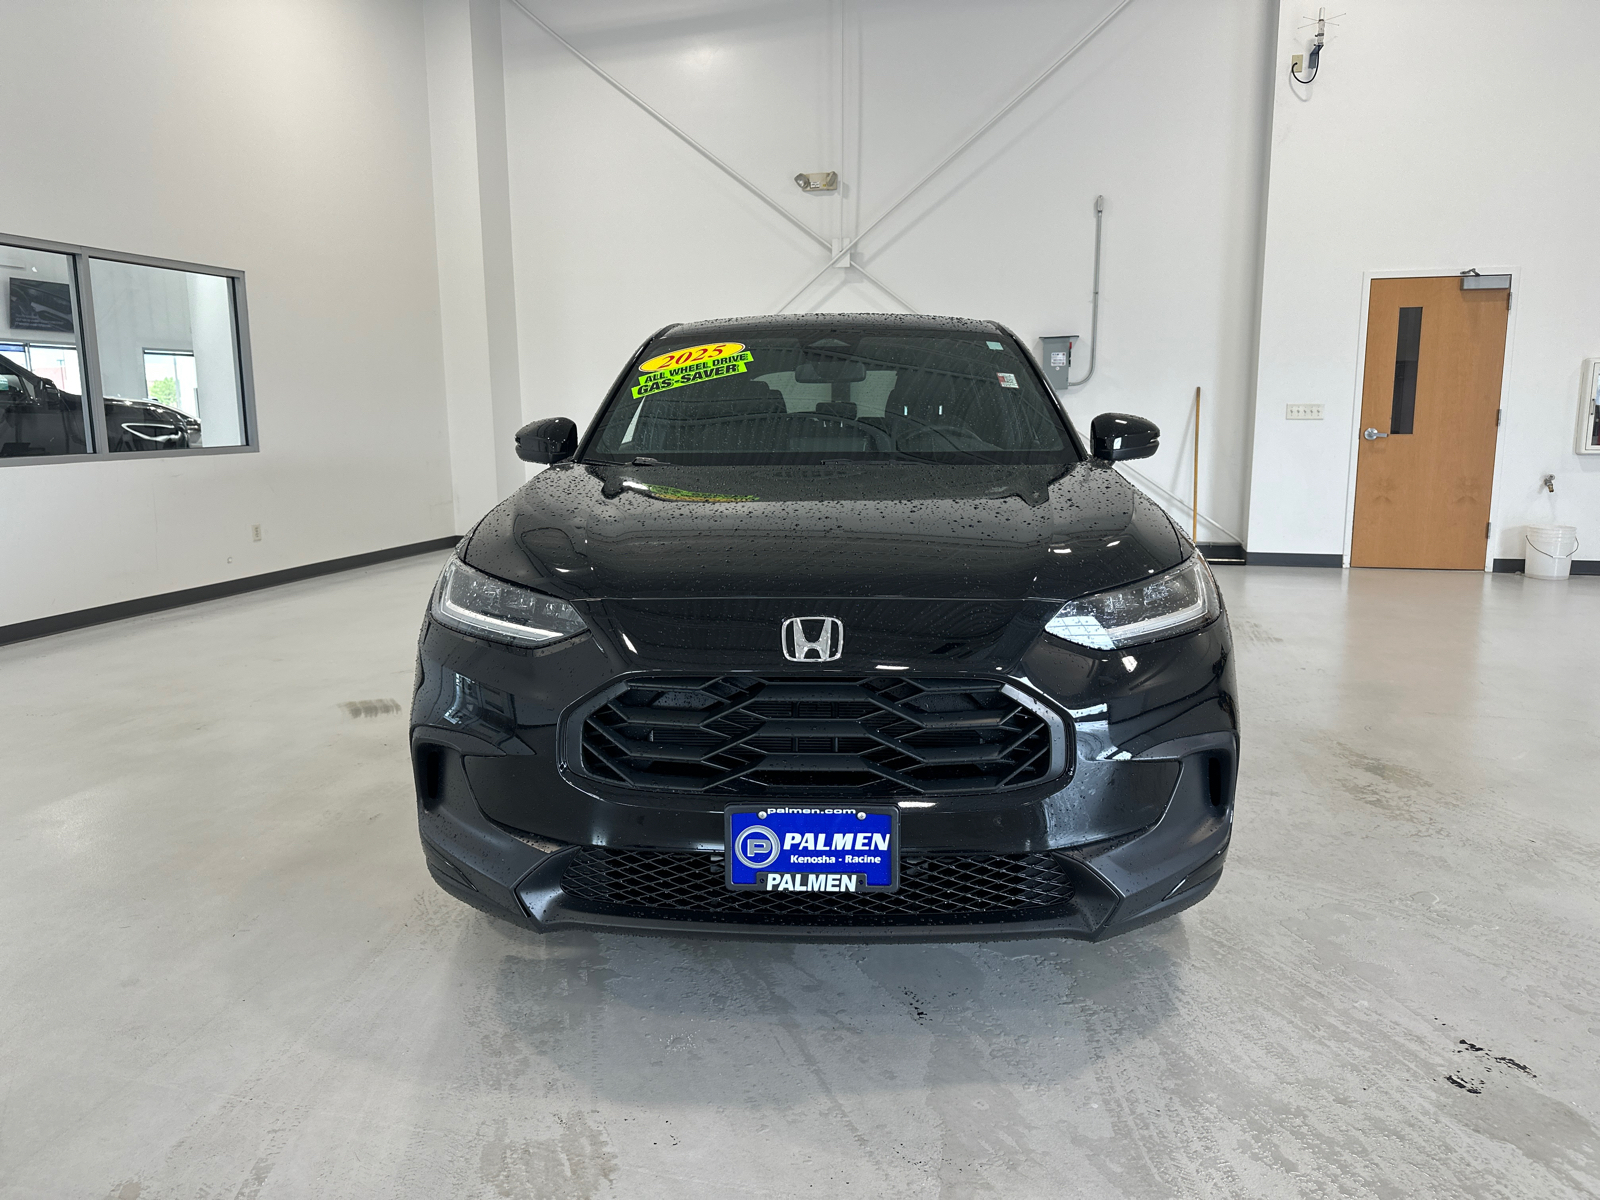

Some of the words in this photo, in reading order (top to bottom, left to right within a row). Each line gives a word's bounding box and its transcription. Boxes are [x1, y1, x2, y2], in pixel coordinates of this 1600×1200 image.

[657, 344, 726, 369] 2025
[644, 372, 665, 383] ALL
[669, 361, 711, 377] WHEEL
[712, 353, 747, 366] DRIVE
[637, 364, 738, 395] GAS-SAVER
[767, 807, 857, 815] palmen.com
[747, 839, 771, 857] P
[783, 832, 890, 851] PALMEN
[790, 855, 836, 864] Kenosha
[845, 855, 881, 864] Racine
[766, 873, 857, 892] PALMEN
